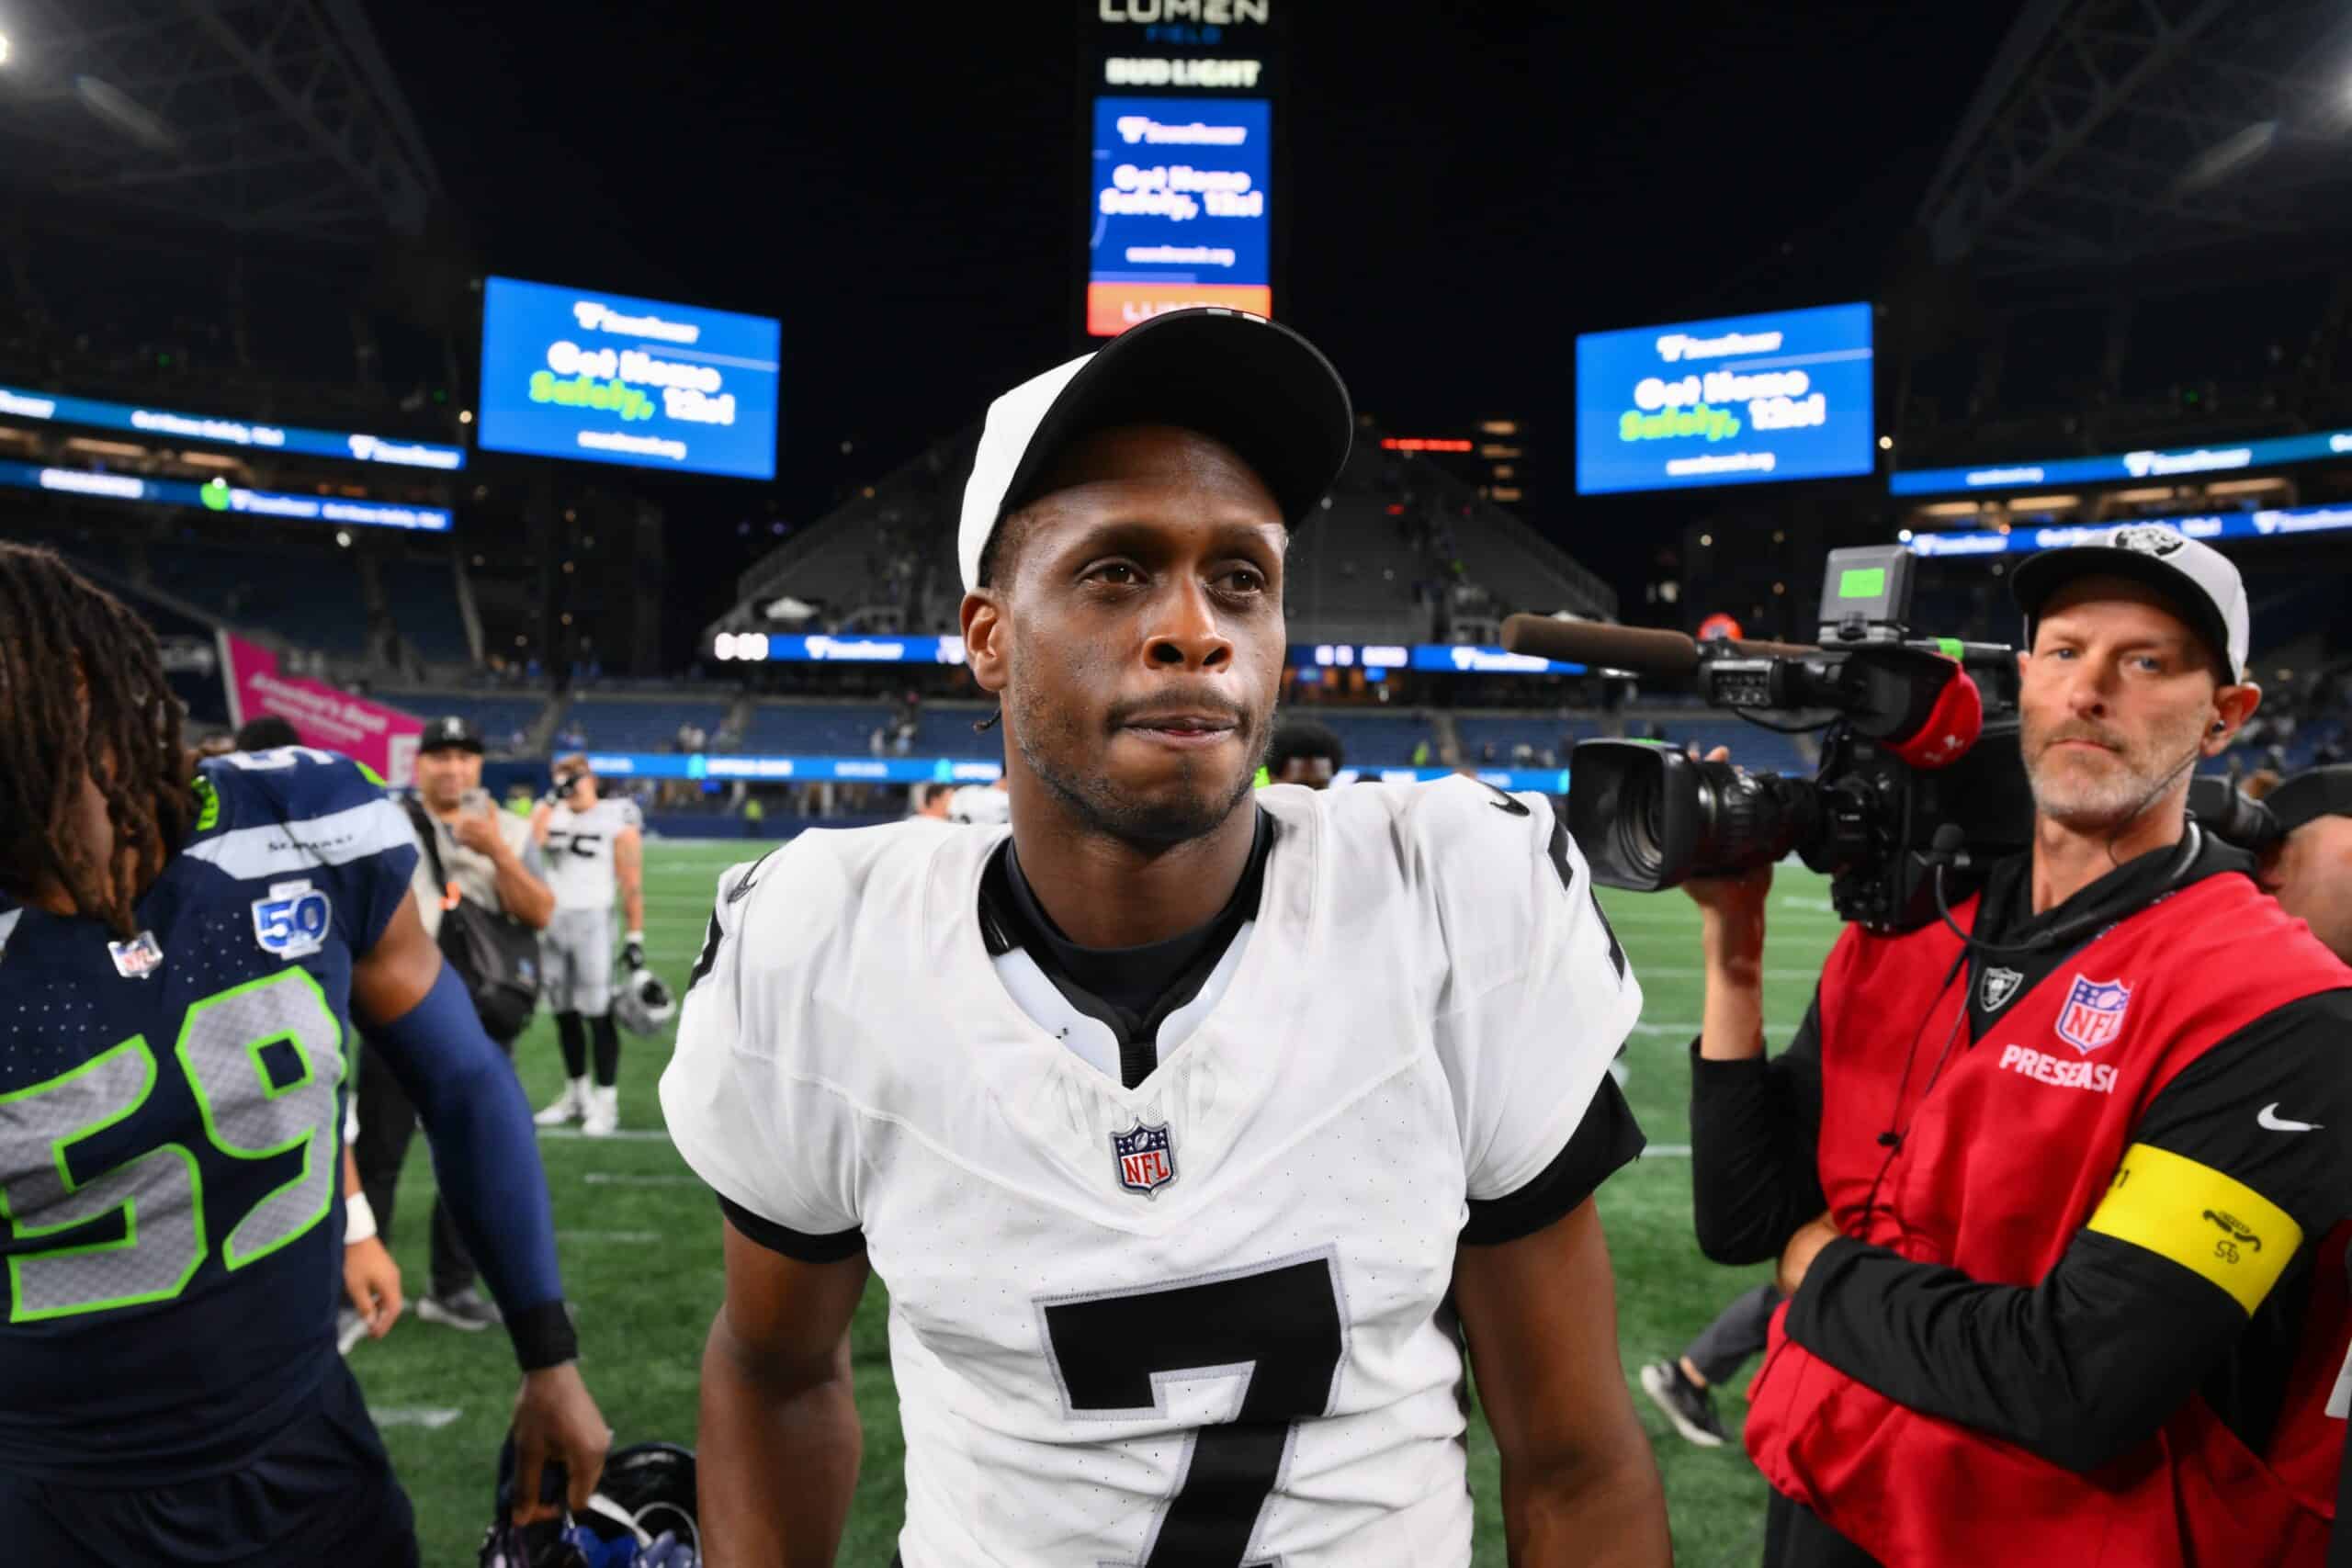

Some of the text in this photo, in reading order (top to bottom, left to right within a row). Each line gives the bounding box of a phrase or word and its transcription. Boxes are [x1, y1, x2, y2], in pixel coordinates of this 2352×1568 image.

[1105, 57, 1261, 87] BUD LIGHT
[256, 894, 328, 949] 50
[1998, 1043, 2120, 1095] PRESEAS
[0, 964, 349, 1325] 59
[1122, 1151, 1170, 1185] NFL
[1032, 1242, 1352, 1568] 7
